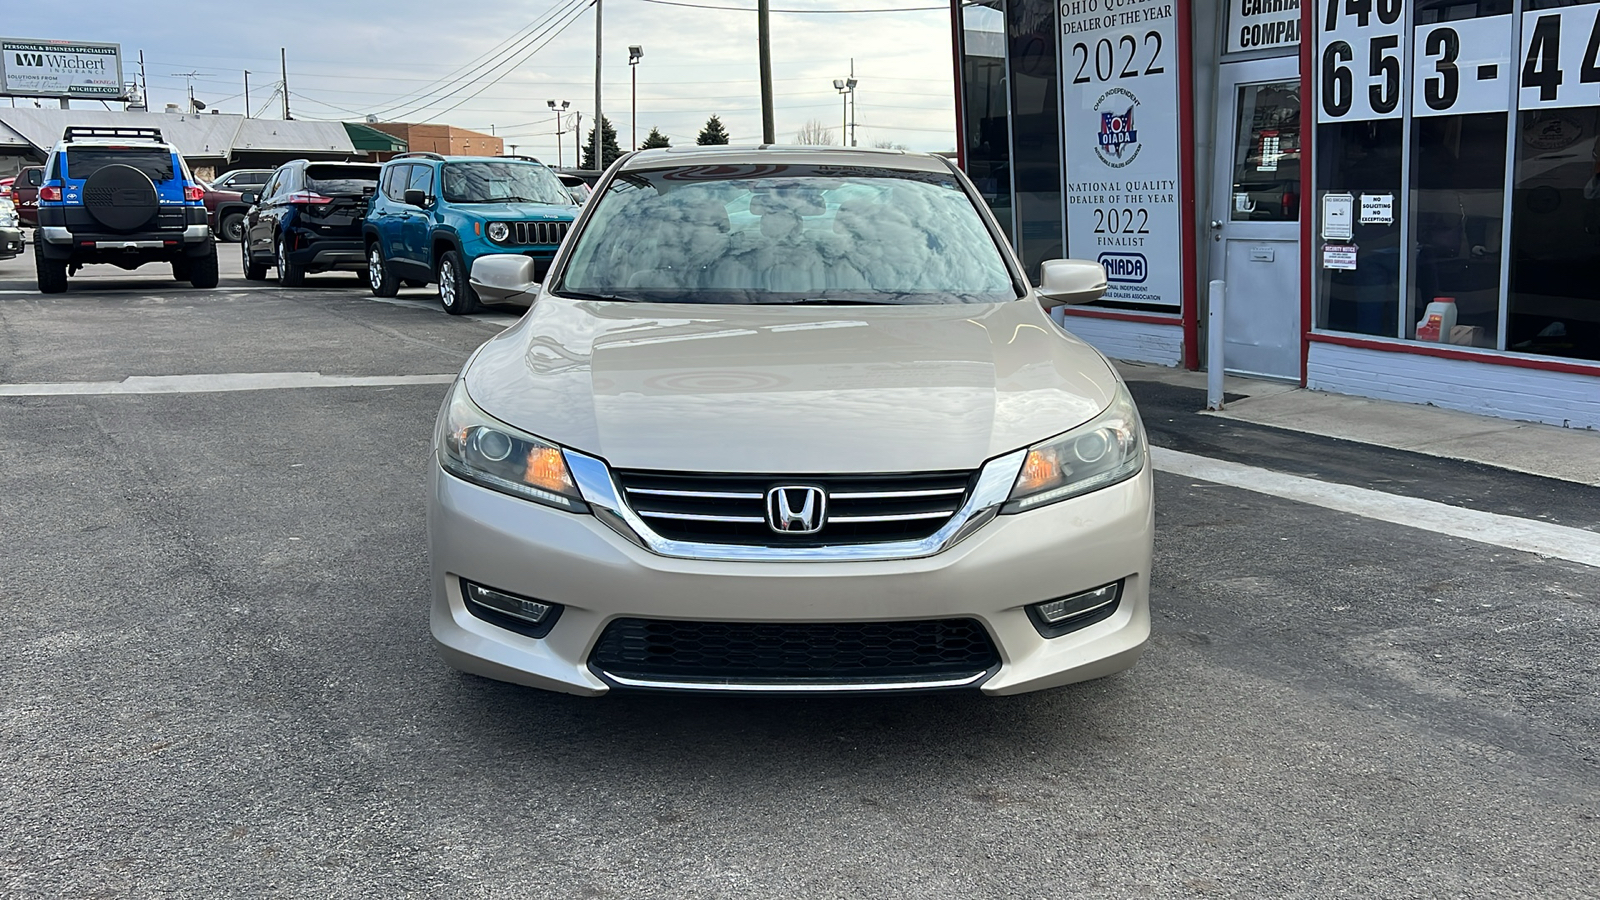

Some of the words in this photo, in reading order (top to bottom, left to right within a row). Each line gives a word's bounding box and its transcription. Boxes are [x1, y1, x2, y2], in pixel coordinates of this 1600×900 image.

[1061, 0, 1098, 17] OHIO
[1063, 17, 1102, 35] DEALER
[1103, 14, 1118, 28] OF
[1119, 10, 1141, 25] THE
[1143, 4, 1173, 21] YEAR
[45, 54, 106, 70] Wichert
[1072, 30, 1165, 85] 2022
[1102, 131, 1131, 144] OIADA
[1068, 181, 1121, 192] NATIONAL
[1126, 180, 1176, 192] QUALITY
[1069, 194, 1105, 204] DEALER
[1108, 194, 1121, 204] OF
[1124, 194, 1144, 204] THE
[1147, 193, 1175, 203] YEAR
[1093, 208, 1150, 234] 2022
[1097, 237, 1145, 247] FINALIST
